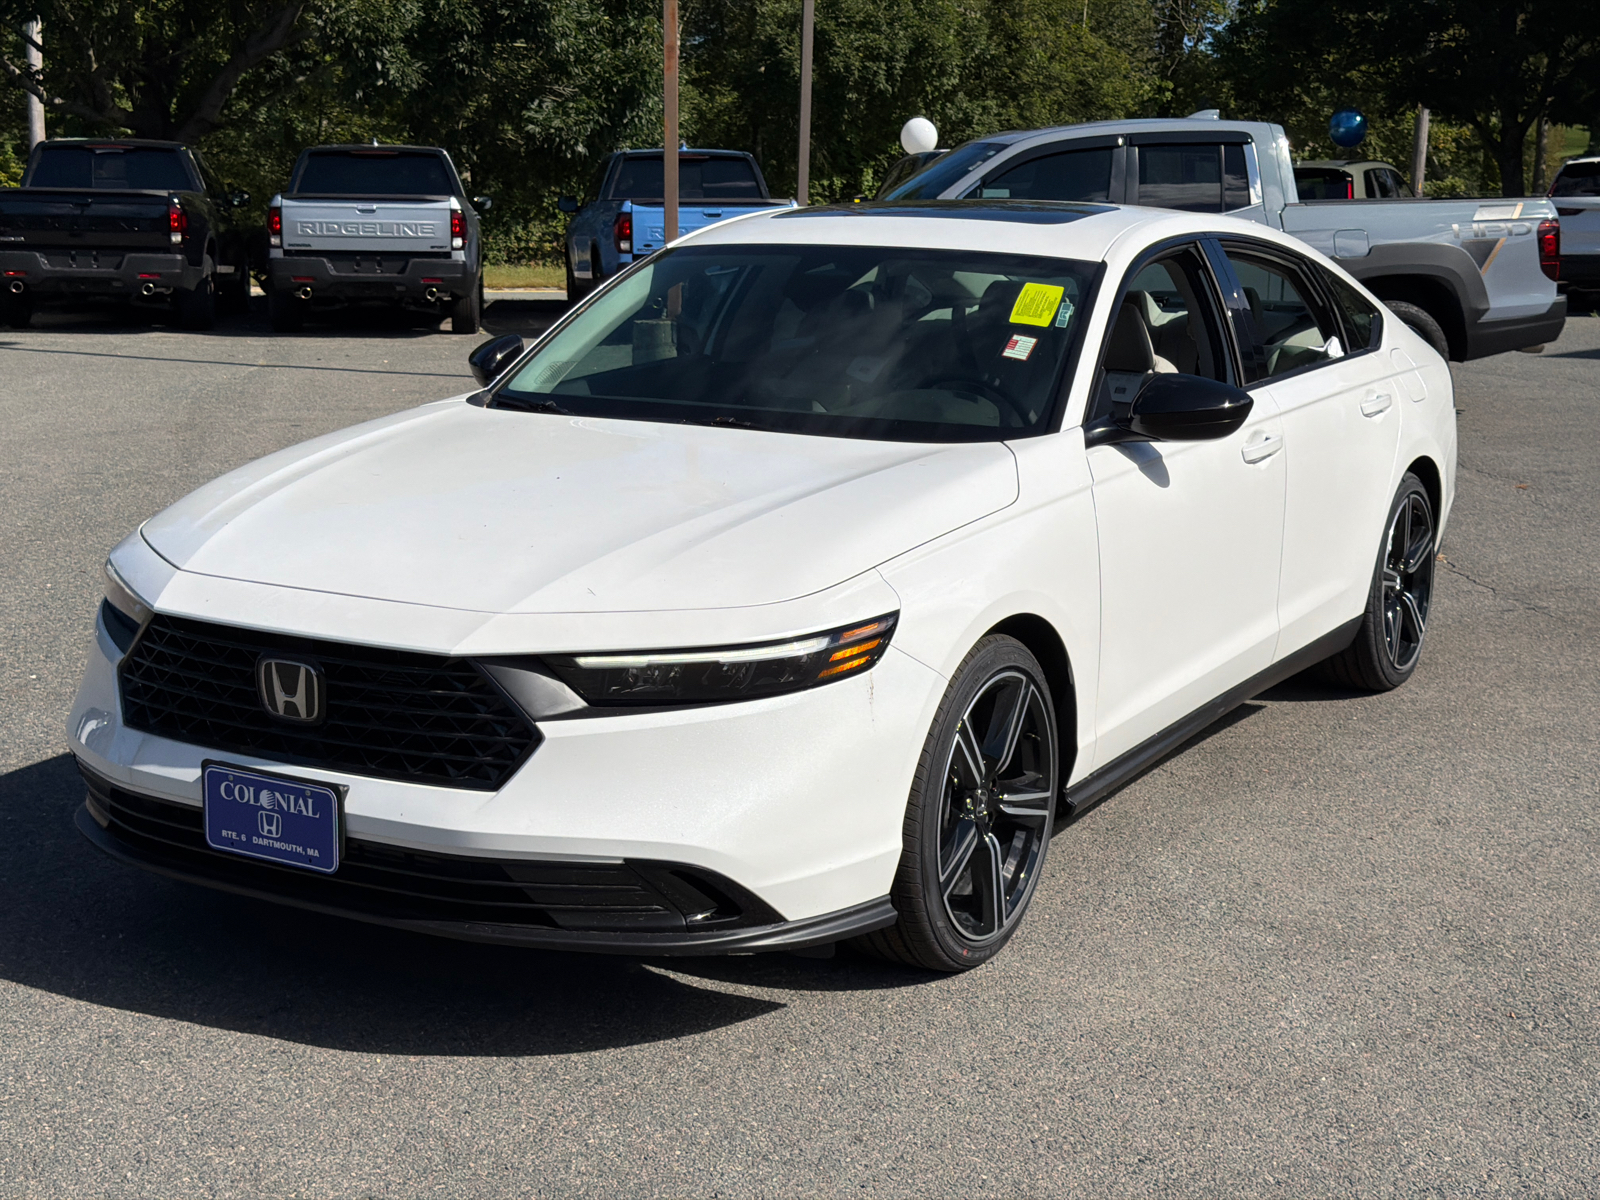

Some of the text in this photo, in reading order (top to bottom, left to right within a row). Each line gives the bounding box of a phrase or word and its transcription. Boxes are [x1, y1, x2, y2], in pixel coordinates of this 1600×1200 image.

[297, 221, 435, 236] RIDGELINE
[220, 781, 320, 819] COLONIAL
[221, 829, 320, 858] RTE. 6 DARTMOUTH, MA
